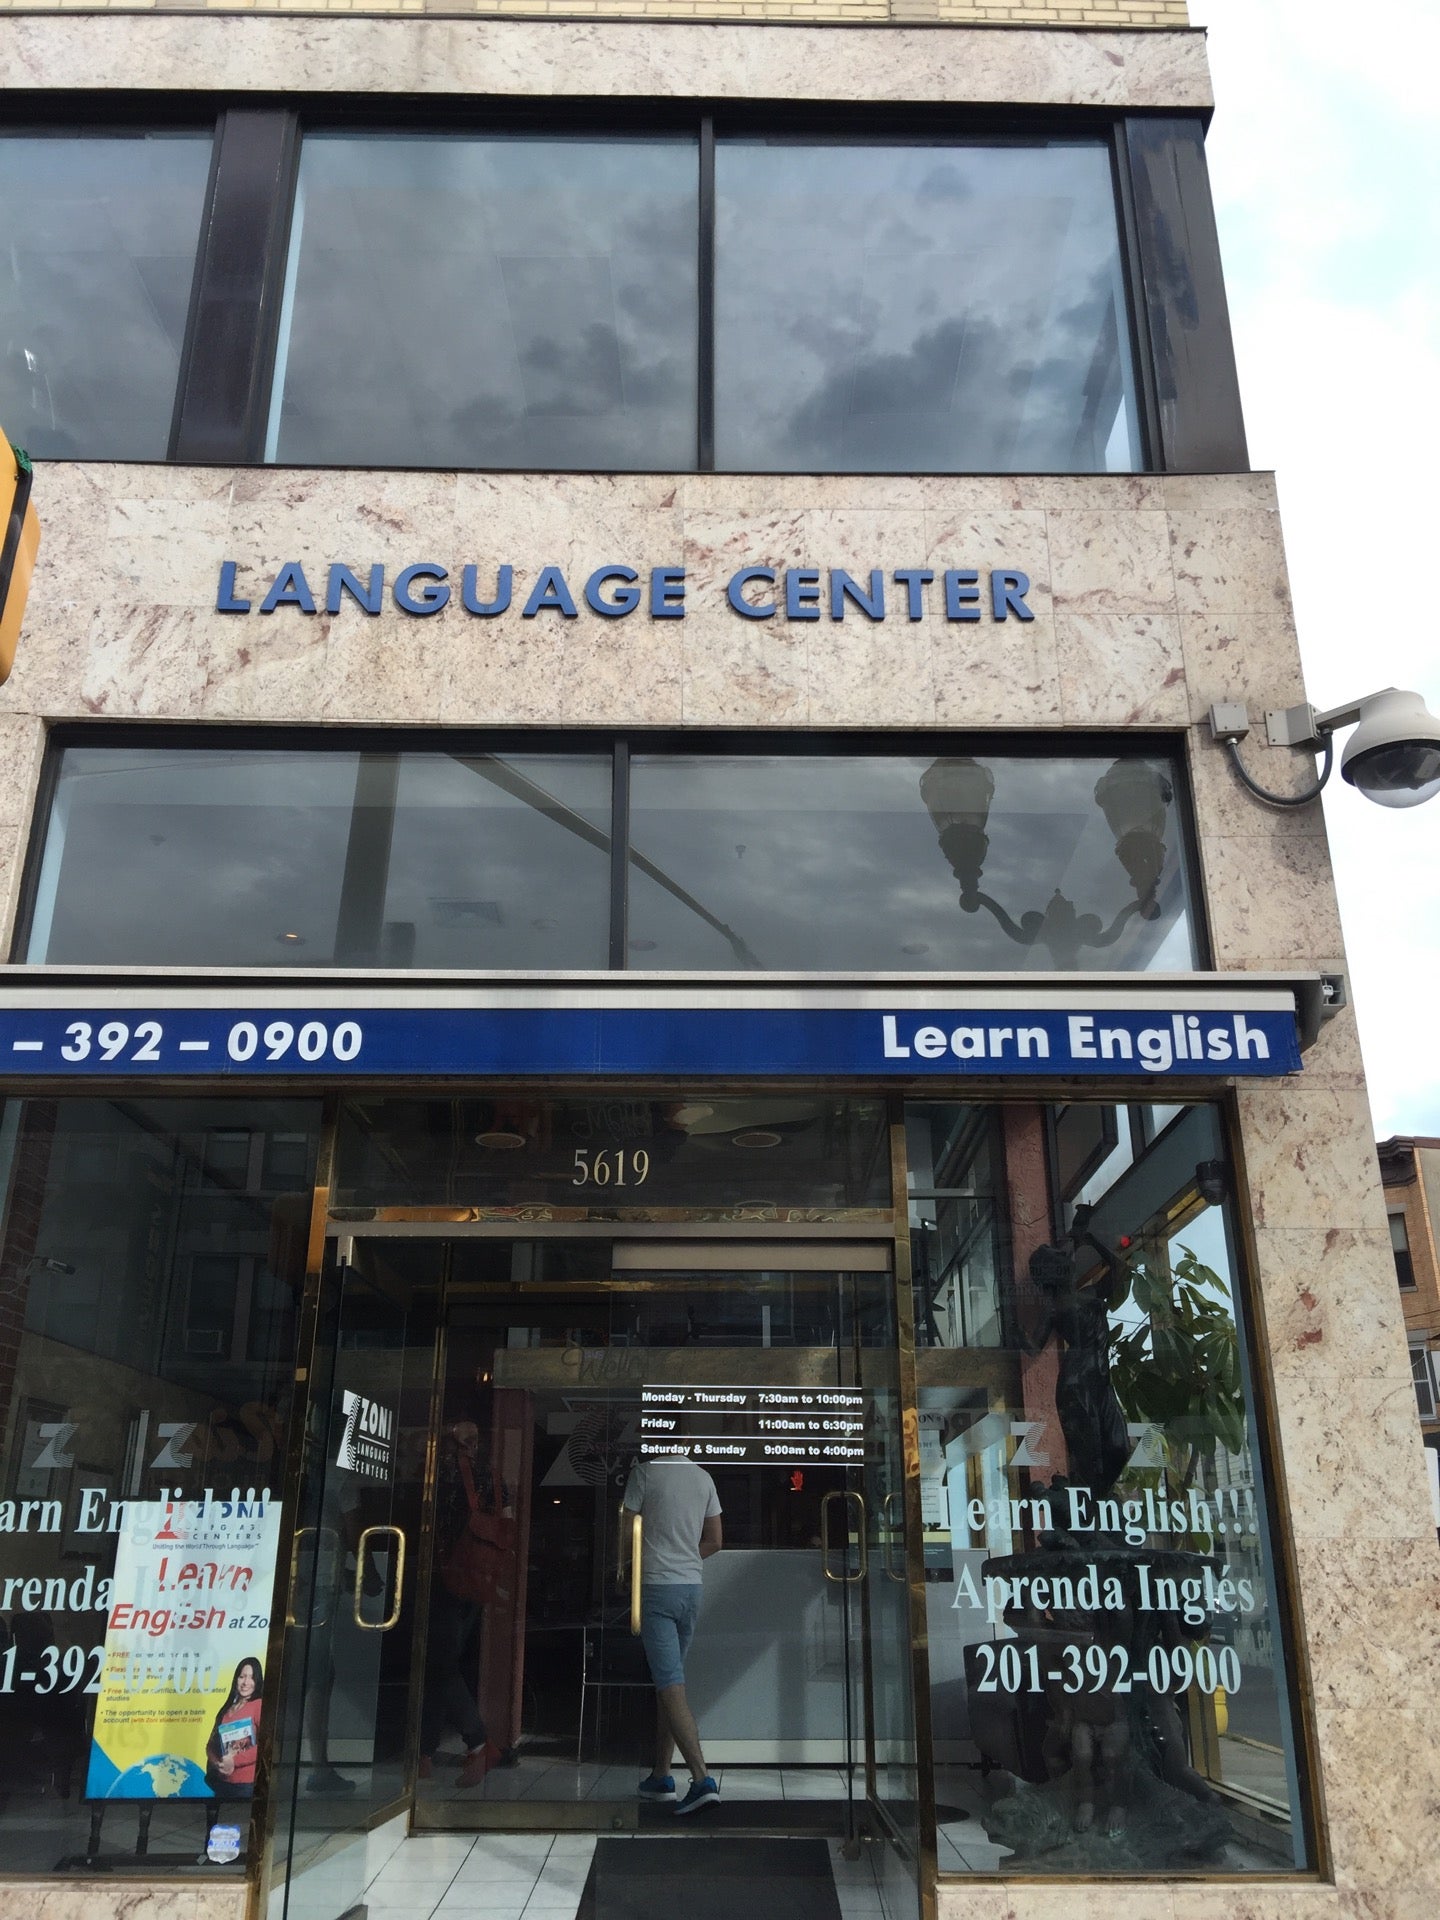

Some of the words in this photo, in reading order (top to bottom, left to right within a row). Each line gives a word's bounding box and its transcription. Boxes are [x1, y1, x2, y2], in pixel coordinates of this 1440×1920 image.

[215, 561, 685, 619] LANGUAGE
[728, 565, 1036, 622] CENTER
[61, 1021, 163, 1062] 392
[227, 1021, 363, 1062] 0900
[882, 1015, 1050, 1059] Learn
[1067, 1014, 1270, 1072] English
[572, 1149, 649, 1186] 5619
[642, 1392, 685, 1404] Monday
[694, 1392, 747, 1404] Thursday
[758, 1393, 799, 1403] 7:30am
[801, 1395, 812, 1403] to
[816, 1394, 863, 1405] 10:00pm
[359, 1397, 392, 1441] ZONI
[641, 1418, 676, 1430] Friday
[758, 1420, 805, 1430] 11:00am
[808, 1421, 820, 1430] to
[822, 1420, 863, 1432] 6:30pm
[355, 1460, 388, 1480] CENTERS
[357, 1442, 390, 1464] LANGUAGE
[641, 1444, 690, 1456] Saturday
[694, 1445, 702, 1453] &
[705, 1444, 746, 1456] Sunday
[764, 1445, 805, 1455] 9:00am
[808, 1446, 820, 1455] to
[823, 1446, 864, 1457] 4:00pm
[937, 1486, 1055, 1532] Learn
[1065, 1486, 1256, 1545] English!!!
[951, 1563, 1125, 1623] Aprenda
[1134, 1564, 1256, 1625] Inglés
[108, 1603, 226, 1636] Engish
[229, 1617, 244, 1629] at
[248, 1615, 270, 1629] Zo
[976, 1645, 1242, 1695] 201-392-0900
